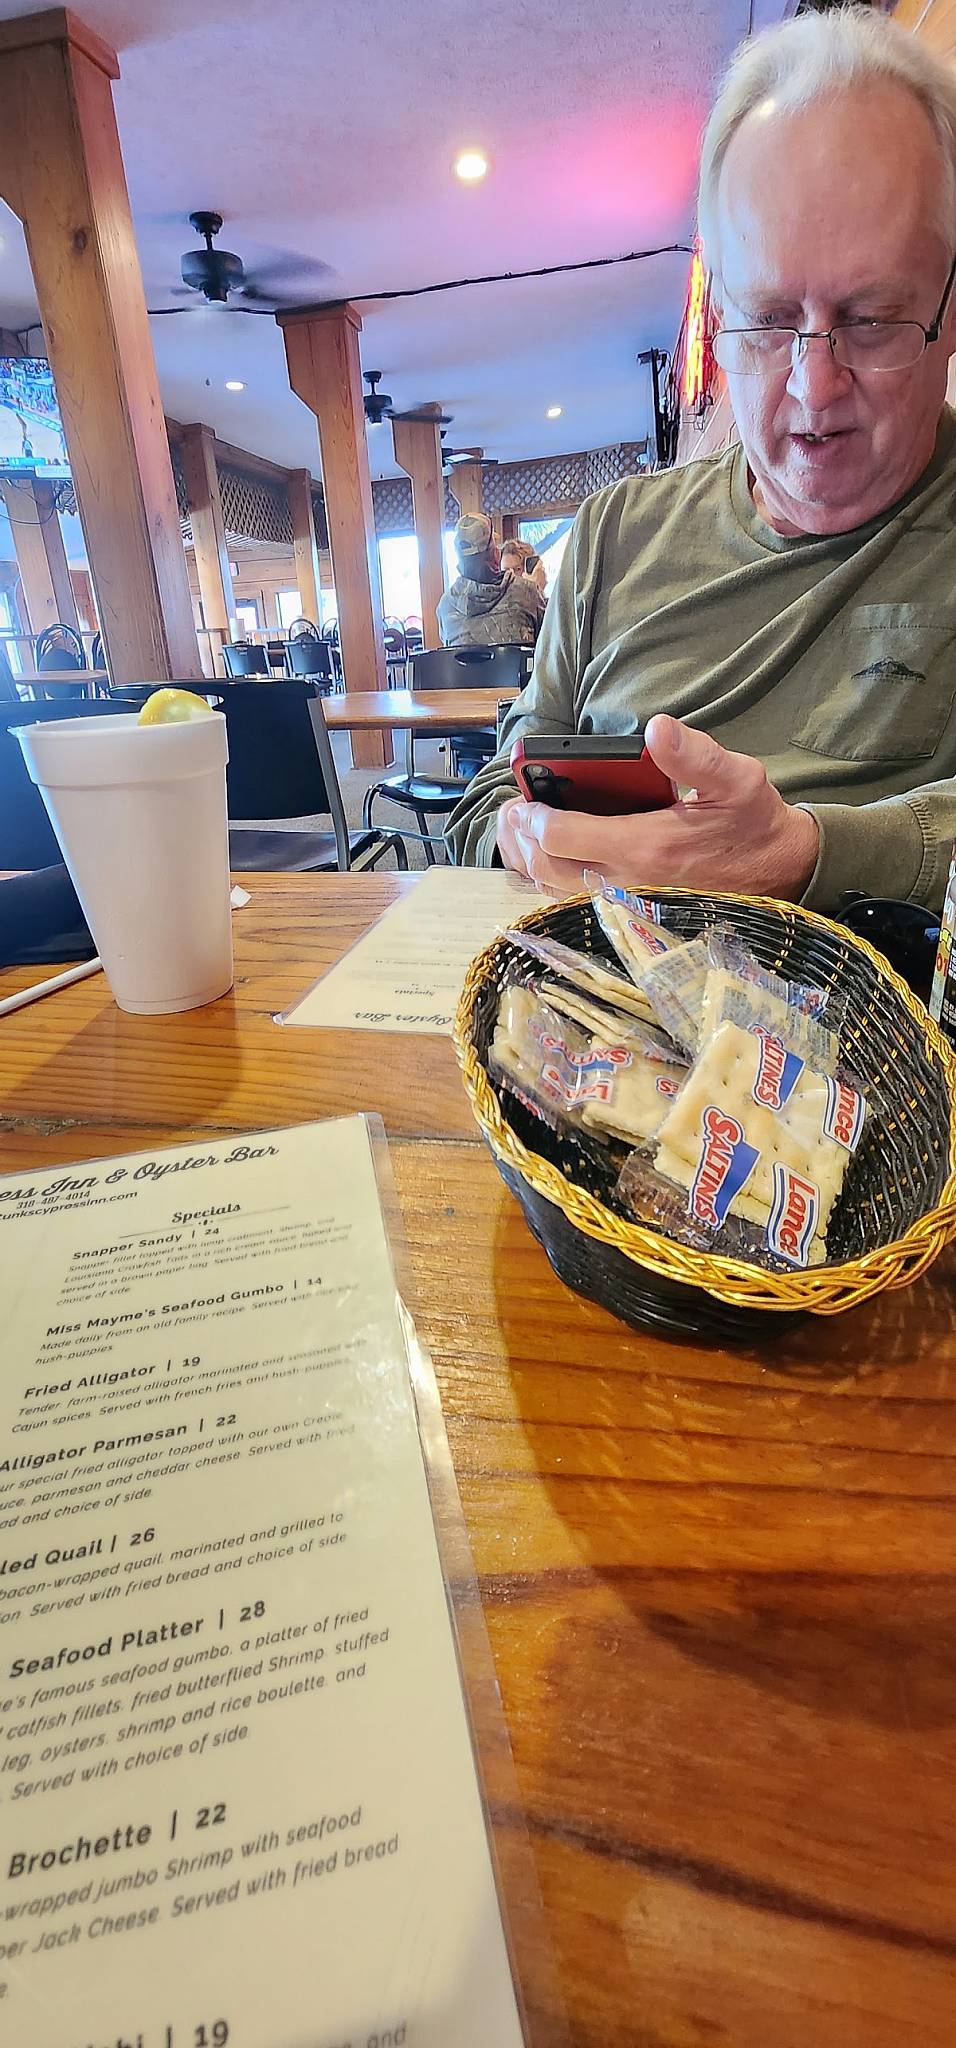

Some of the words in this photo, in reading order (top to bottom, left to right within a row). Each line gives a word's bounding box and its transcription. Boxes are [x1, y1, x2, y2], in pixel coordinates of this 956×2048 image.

[353, 1012, 391, 1023] Bar
[41, 1176, 100, 1196] Inn
[105, 1168, 128, 1184] &
[133, 1155, 219, 1181] Oyster
[224, 1145, 280, 1163] Bar
[172, 1203, 241, 1224] Specials
[779, 1173, 816, 1257] Lance
[72, 1242, 133, 1260] Snapper
[138, 1234, 182, 1248] Sandy
[204, 1228, 219, 1236] 24
[40, 1340, 72, 1351] Made
[75, 1334, 103, 1345] daily
[105, 1329, 133, 1340] from
[136, 1325, 150, 1333] an
[153, 1320, 171, 1329] old
[174, 1312, 209, 1325] family
[46, 1322, 81, 1336] Miss
[87, 1309, 156, 1329] Mayme's
[161, 1295, 225, 1314] Seafood
[231, 1284, 284, 1300] Gumbo
[307, 1277, 322, 1286] 14
[24, 1380, 72, 1399] Fried
[76, 1365, 156, 1389] Alligator
[182, 1356, 201, 1367] 19
[35, 1345, 114, 1365] hush-puppies
[11, 1420, 48, 1434] Cajun
[99, 1399, 141, 1416] Served
[144, 1394, 170, 1405] with
[174, 1385, 212, 1401] french
[215, 1380, 242, 1393] fries
[246, 1374, 269, 1385] and
[67, 1385, 141, 1409] farm-raised
[143, 1373, 195, 1392] alligator
[198, 1361, 258, 1380] marinated
[0, 1445, 87, 1472] Alligator
[93, 1425, 187, 1453] Parmesan
[215, 1413, 237, 1428] 22
[18, 1470, 69, 1489] special
[71, 1462, 104, 1479] fried
[107, 1451, 164, 1471] alligator
[168, 1439, 214, 1457] topped
[218, 1433, 244, 1446] with
[248, 1427, 269, 1439] our
[273, 1421, 299, 1433] own
[31, 1481, 102, 1505] parmesan
[105, 1474, 132, 1488] and
[136, 1461, 191, 1482] cheddar
[248, 1438, 292, 1457] Served
[296, 1432, 322, 1446] with
[22, 1508, 51, 1525] and
[54, 1499, 100, 1518] choice
[104, 1491, 121, 1508] of
[170, 1534, 245, 1561] marinated
[249, 1525, 277, 1543] and
[280, 1515, 325, 1538] grilled
[330, 1512, 344, 1525] to
[0, 1553, 38, 1576] led
[45, 1538, 103, 1565] Quail
[130, 1527, 155, 1547] 26
[30, 1593, 85, 1617] Served
[89, 1586, 121, 1602] with
[125, 1576, 162, 1597] fried
[166, 1563, 210, 1585] bread
[214, 1556, 243, 1574] and
[247, 1546, 294, 1566] choice
[299, 1537, 314, 1553] of
[9, 1637, 113, 1679] Seafood
[121, 1618, 204, 1652] Platter
[239, 1600, 266, 1622] 28
[31, 1678, 95, 1708] famous
[100, 1657, 170, 1688] seafood
[239, 1640, 250, 1652] a
[255, 1624, 308, 1650] platter
[313, 1615, 330, 1633] of
[334, 1605, 369, 1630] fried
[6, 1711, 67, 1741] catfish
[130, 1684, 172, 1711] fried
[176, 1660, 263, 1697] butterflied
[335, 1627, 390, 1655] stuffed
[117, 1714, 176, 1743] shrimp
[181, 1702, 216, 1726] and
[220, 1695, 252, 1714] rice
[335, 1662, 366, 1683] and
[10, 1769, 75, 1801] Served
[81, 1757, 119, 1782] with
[124, 1742, 183, 1772] choice
[188, 1732, 209, 1755] of
[7, 1824, 152, 1879] Brochette
[195, 1802, 227, 1830] 22
[93, 1867, 159, 1904] jumbo
[164, 1847, 234, 1881] Shrimp
[241, 1831, 279, 1858] with
[285, 1805, 362, 1847] seafood
[32, 1921, 82, 1953] Jack
[171, 1879, 241, 1918] Served
[247, 1866, 286, 1896] with
[292, 1851, 338, 1888] fried
[344, 1833, 399, 1869] bread
[194, 2017, 230, 2048] 19
